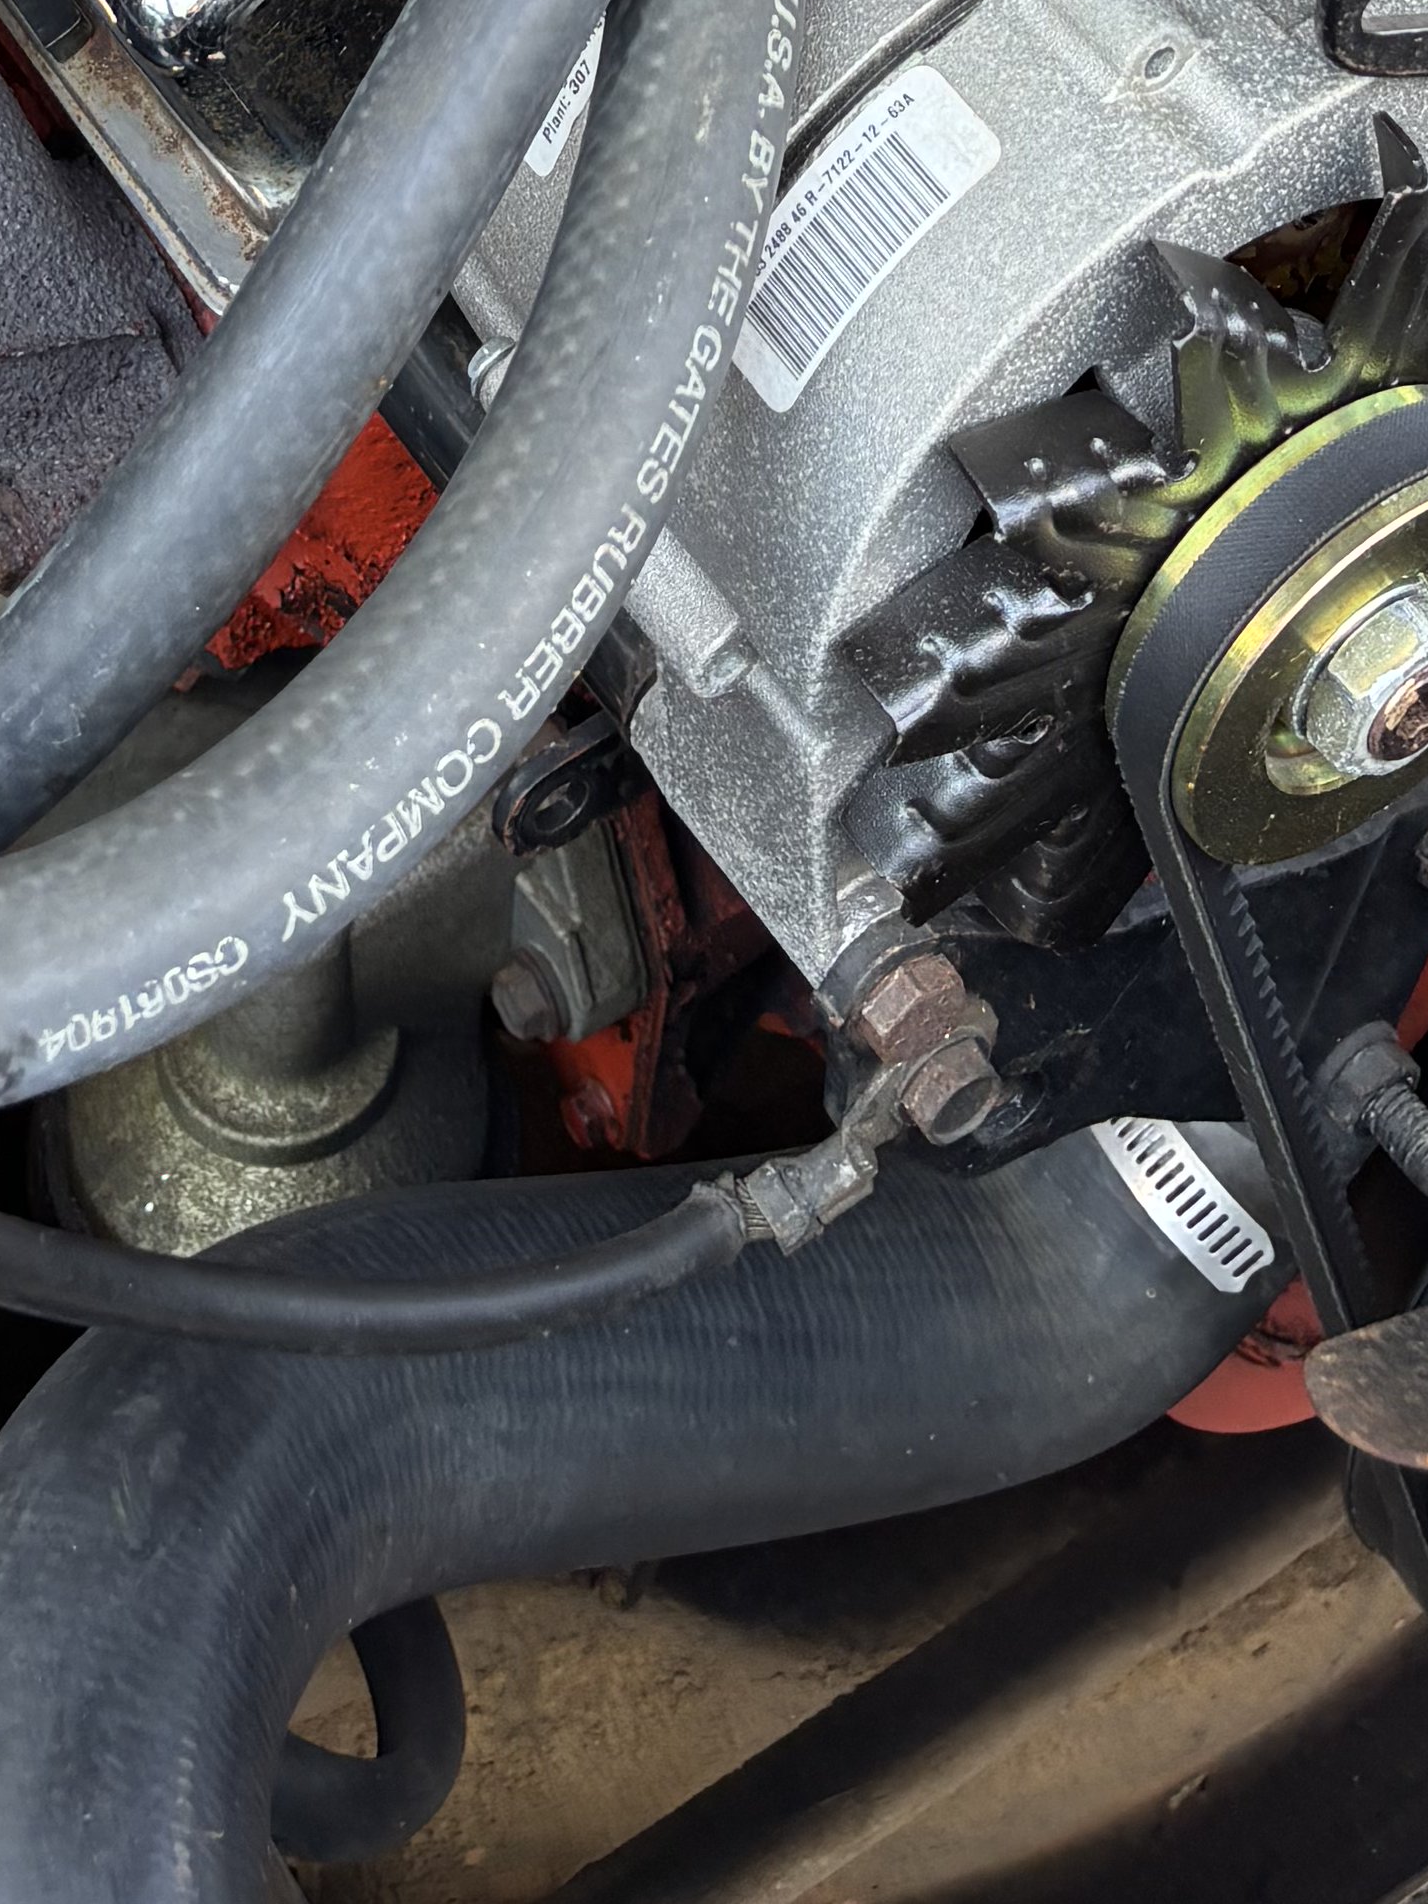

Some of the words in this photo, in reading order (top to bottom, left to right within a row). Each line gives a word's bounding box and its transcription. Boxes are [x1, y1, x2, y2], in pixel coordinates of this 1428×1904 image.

[568, 58, 592, 96] 307
[740, 130, 776, 215] BY
[706, 219, 760, 327] THE
[764, 222, 793, 257] 2488
[791, 205, 808, 224] 46
[635, 323, 724, 504] GATES
[497, 502, 647, 721] RUBBER
[280, 717, 504, 942] COMPANY
